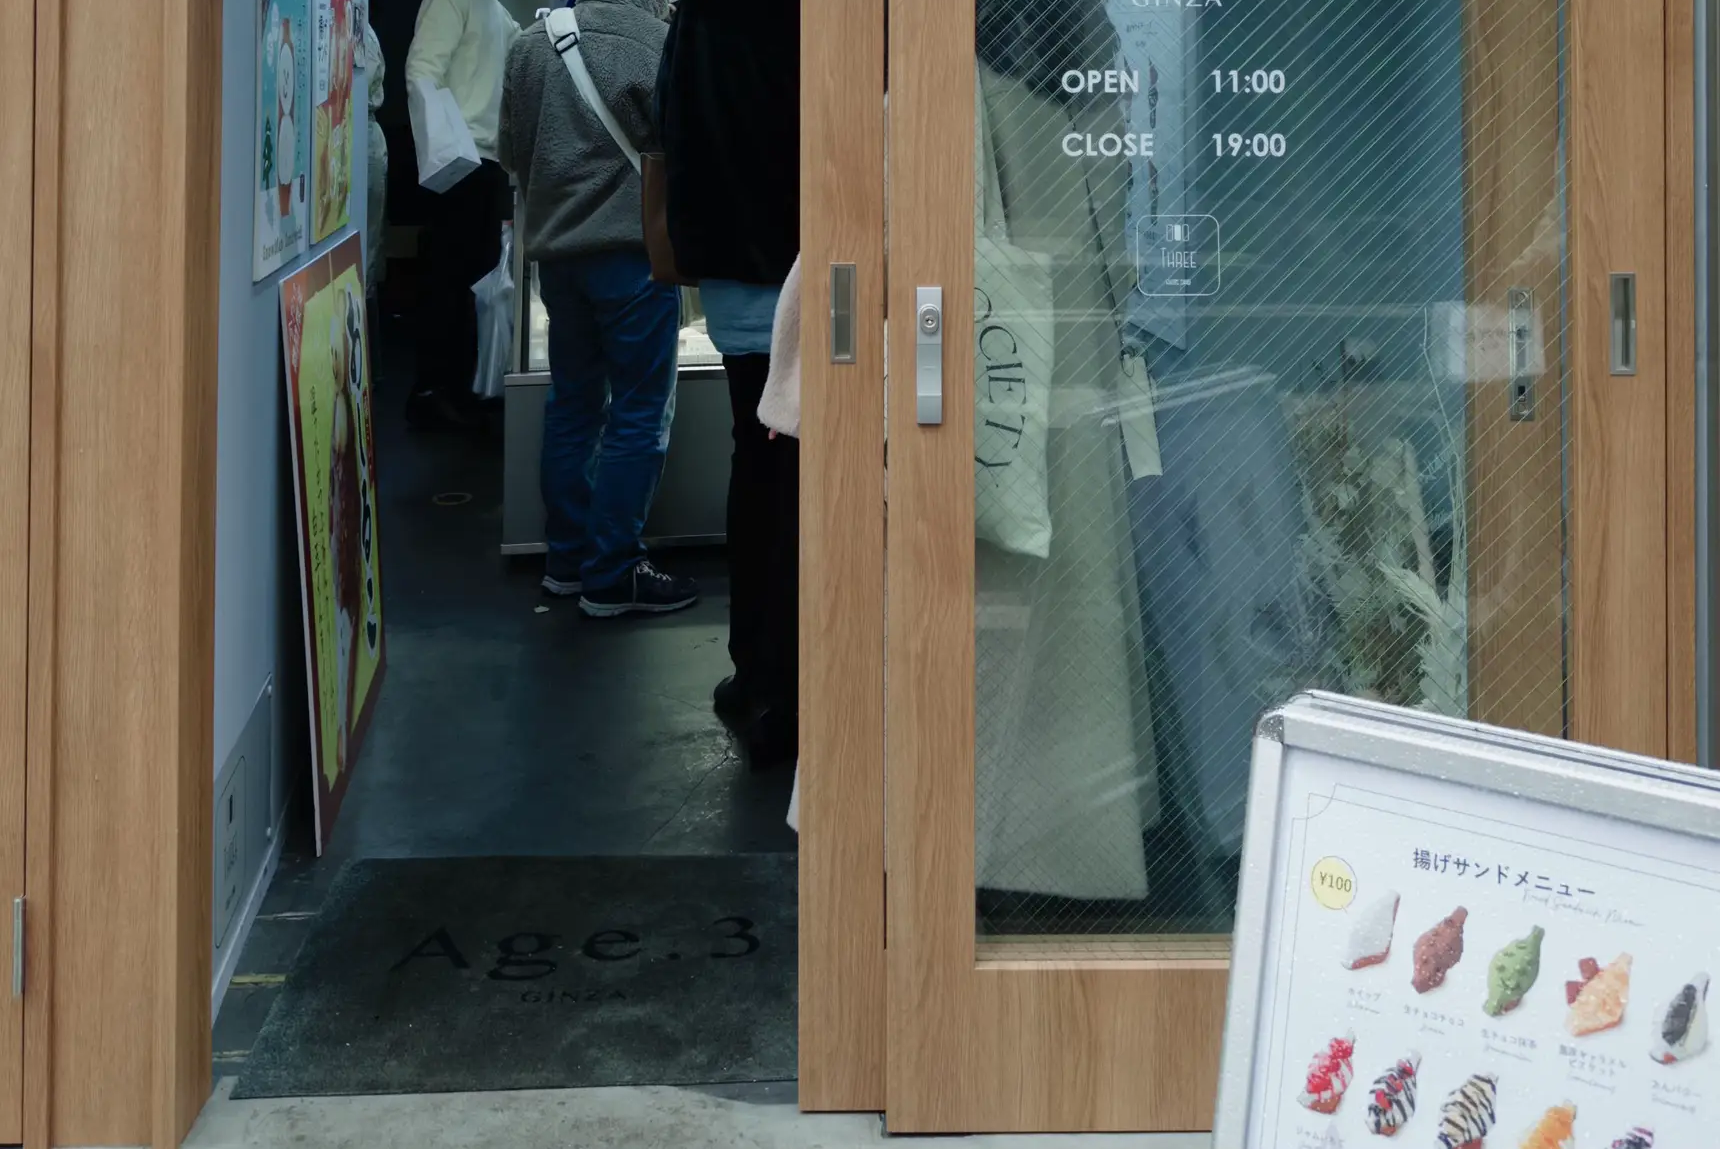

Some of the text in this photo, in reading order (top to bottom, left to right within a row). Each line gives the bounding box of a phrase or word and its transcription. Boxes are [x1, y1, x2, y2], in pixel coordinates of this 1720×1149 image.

[1061, 70, 1286, 94] OPEN 11:00
[1062, 133, 1287, 157] CLOSE 19:00
[1319, 871, 1353, 893] ¥100
[1412, 847, 1596, 897] 揚げサンドメニュー
[391, 916, 761, 981] Age.3
[520, 989, 627, 1004] GINZA
